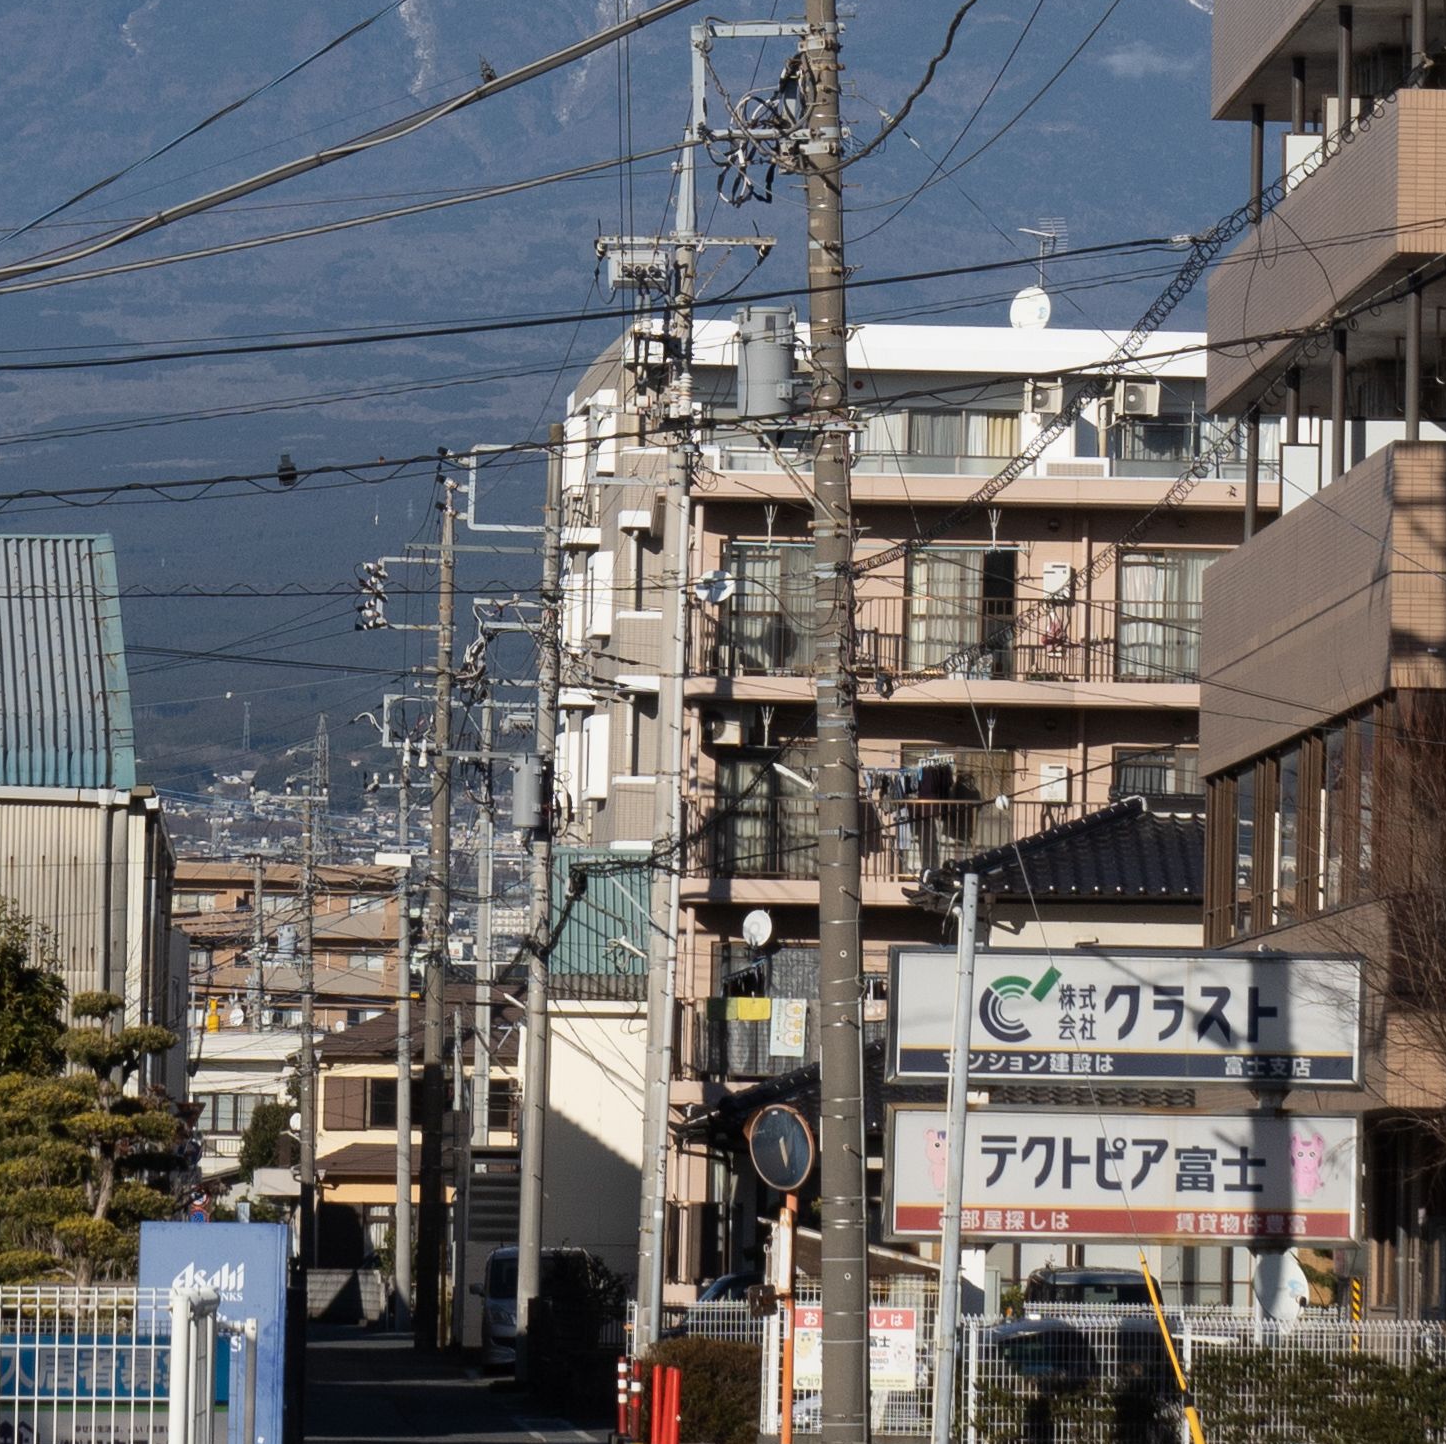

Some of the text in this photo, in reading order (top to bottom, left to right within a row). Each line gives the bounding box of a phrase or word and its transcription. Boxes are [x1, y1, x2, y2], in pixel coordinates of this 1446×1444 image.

[1058, 983, 1097, 1011] 株式
[1058, 1013, 1097, 1041] 会社
[1104, 984, 1278, 1044] クラスト
[1224, 1055, 1312, 1078] 富士支店
[980, 1134, 1267, 1193] テクトピア富士
[1175, 1212, 1308, 1235] 賃貸物件豊富
[171, 1261, 245, 1292] Asahi
